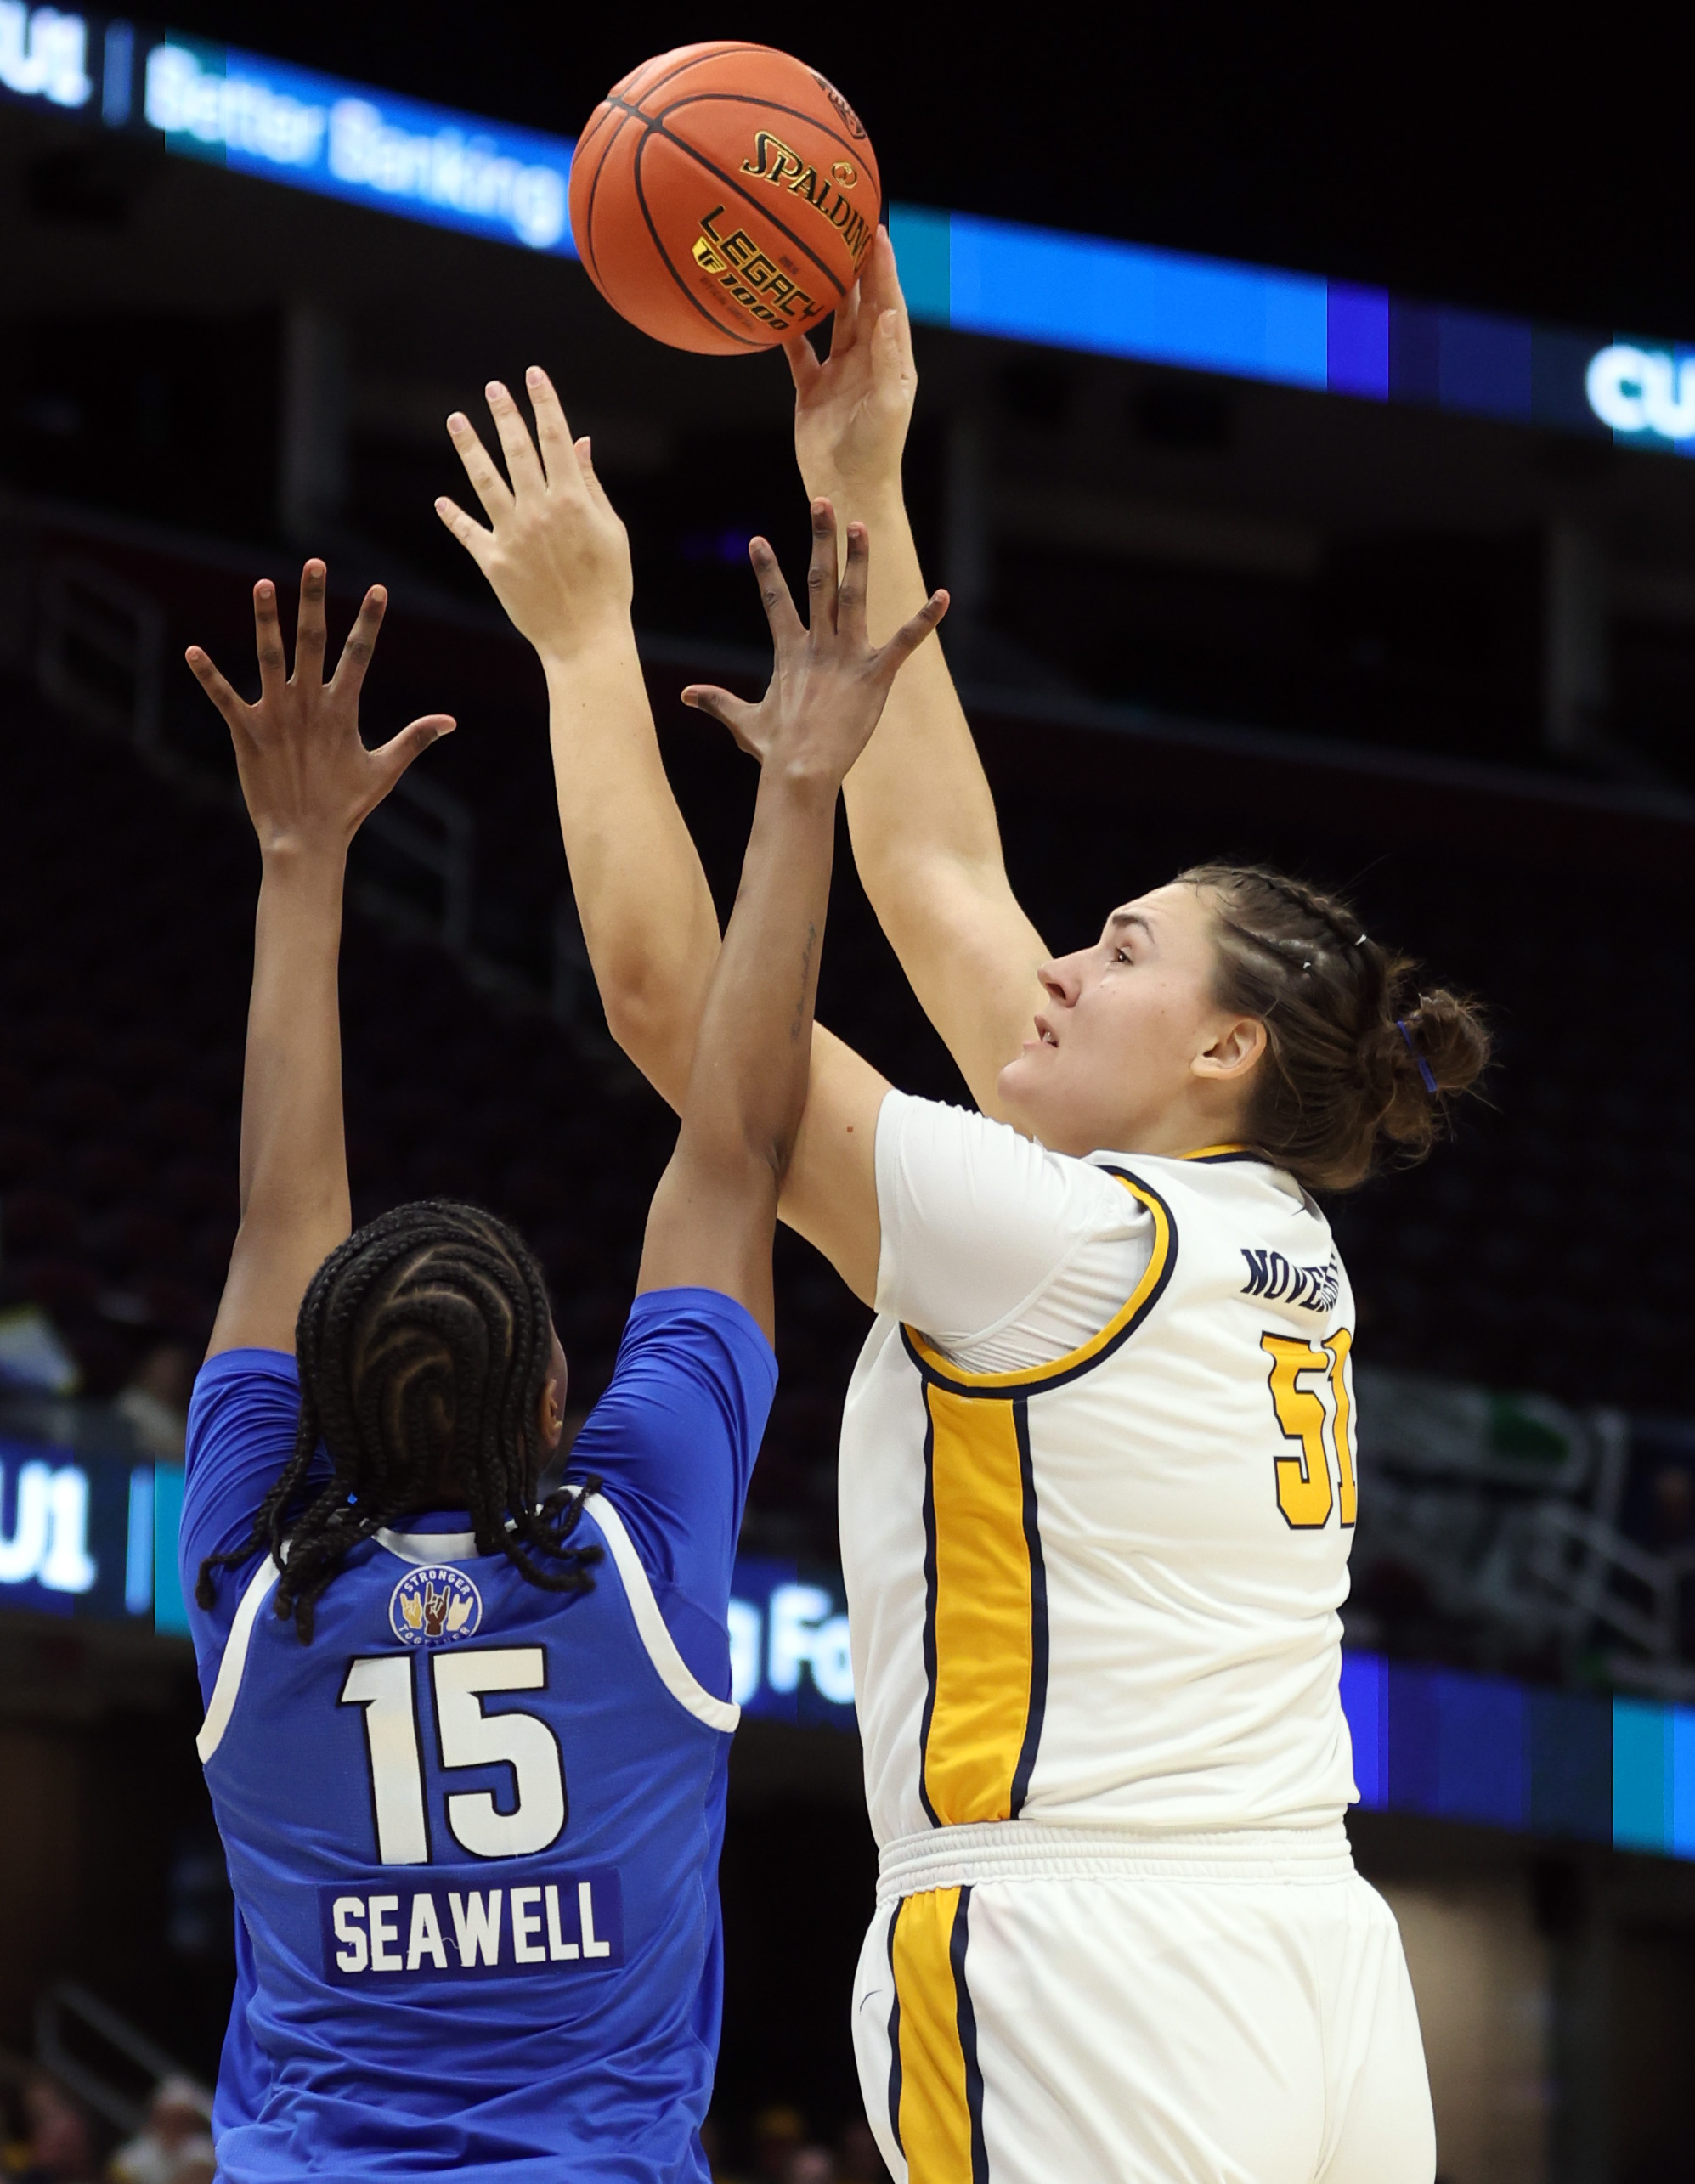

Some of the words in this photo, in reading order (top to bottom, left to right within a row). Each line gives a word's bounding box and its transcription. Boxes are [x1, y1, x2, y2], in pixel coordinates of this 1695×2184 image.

[698, 204, 824, 322] LEGACY
[718, 273, 789, 330] 1000
[1260, 1327, 1357, 1530] 51
[404, 1570, 471, 1595] STRONGER
[336, 1645, 569, 1867] 15
[332, 1881, 610, 1974] SEAWELL
